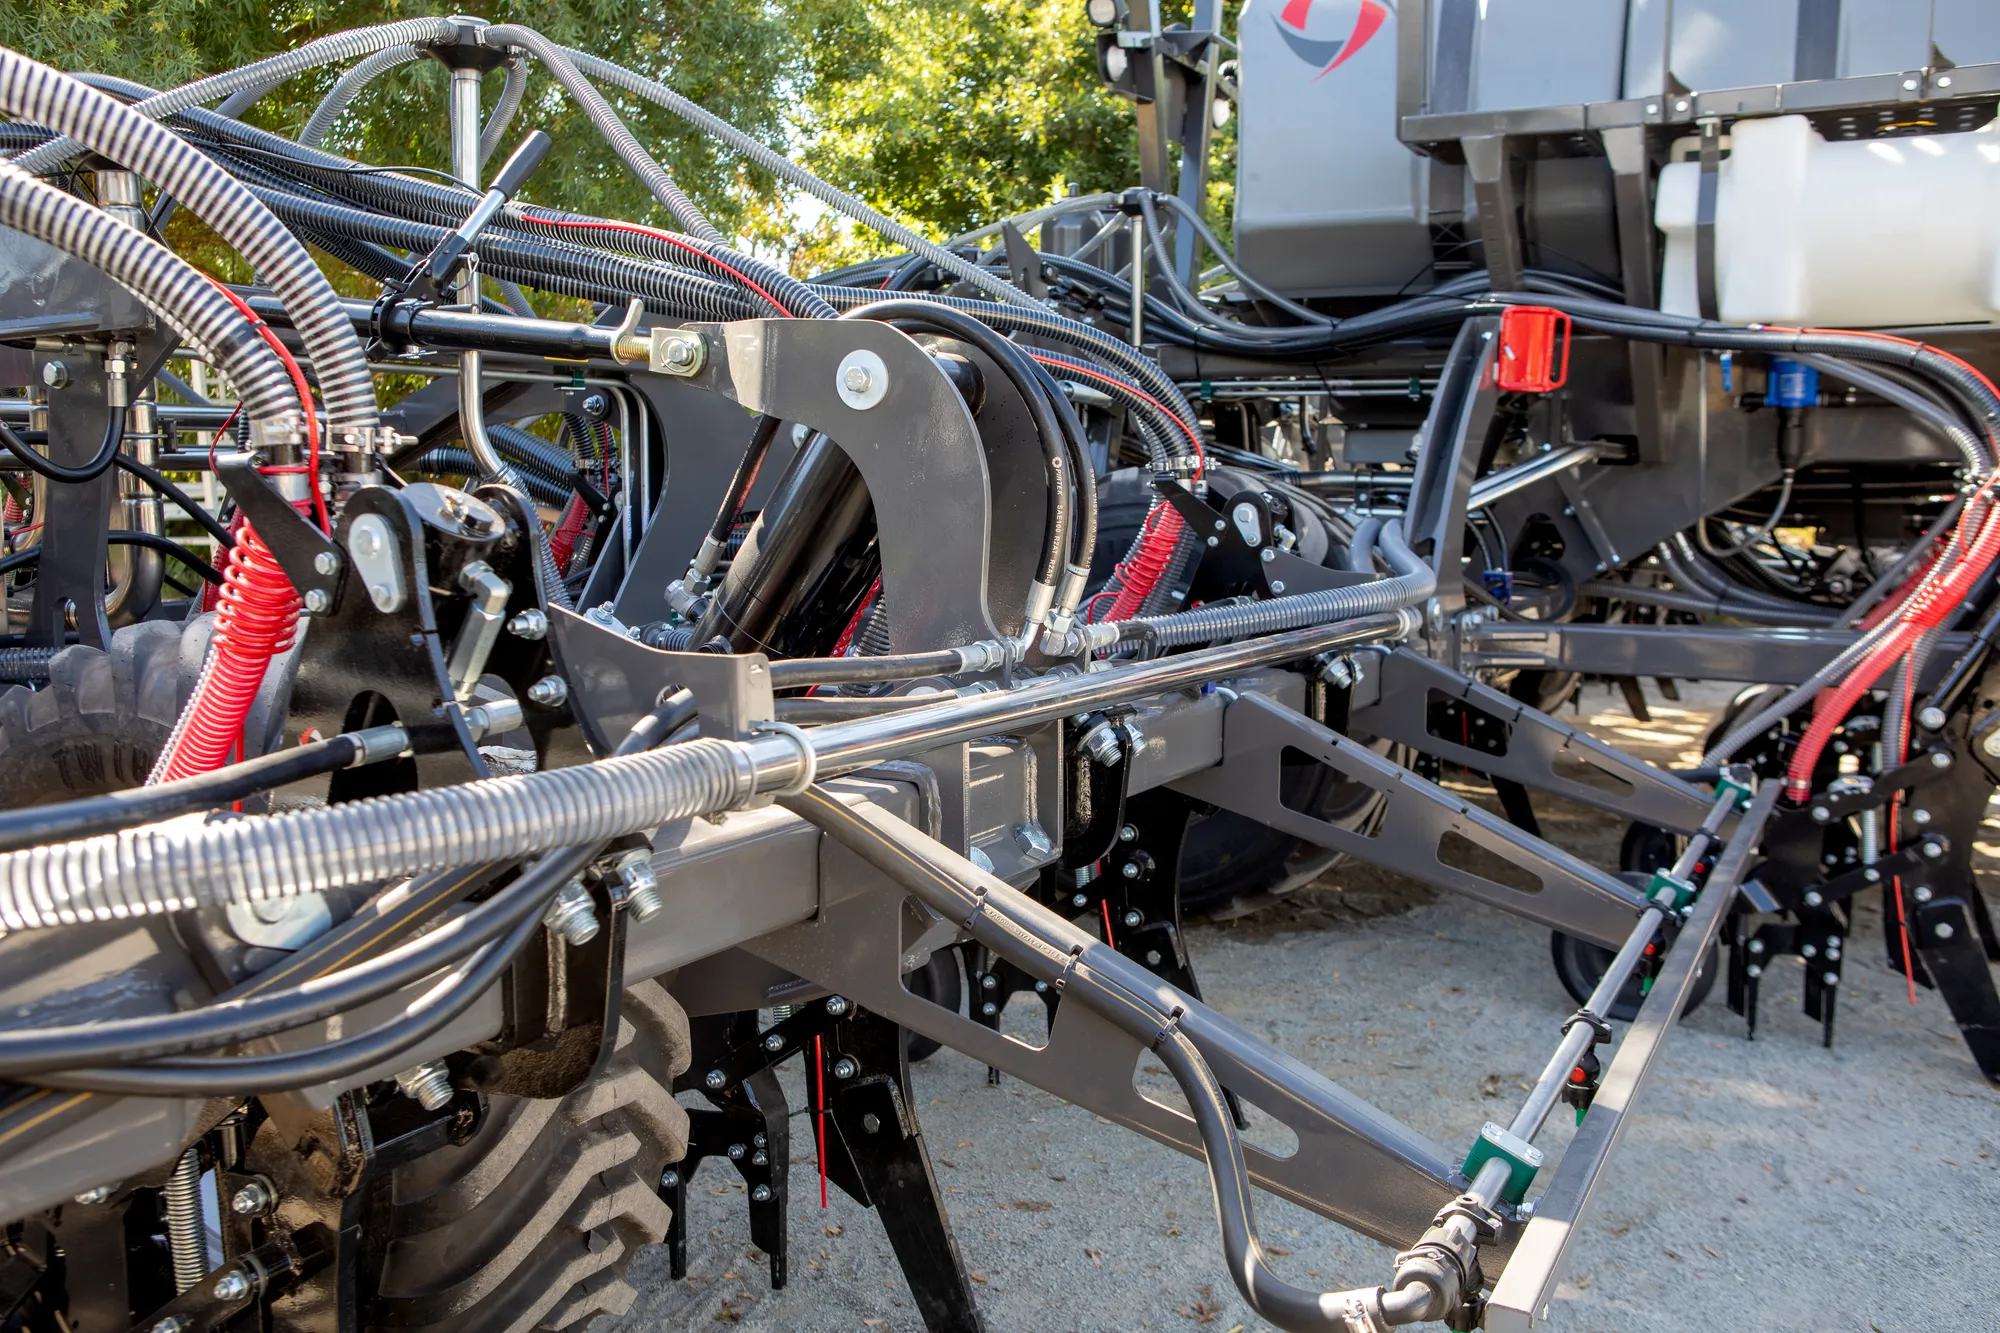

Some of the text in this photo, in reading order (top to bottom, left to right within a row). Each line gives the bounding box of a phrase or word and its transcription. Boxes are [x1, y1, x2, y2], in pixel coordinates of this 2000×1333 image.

[1044, 468, 1064, 585] PIRTEK SAE100 R2AT R2AT-0
